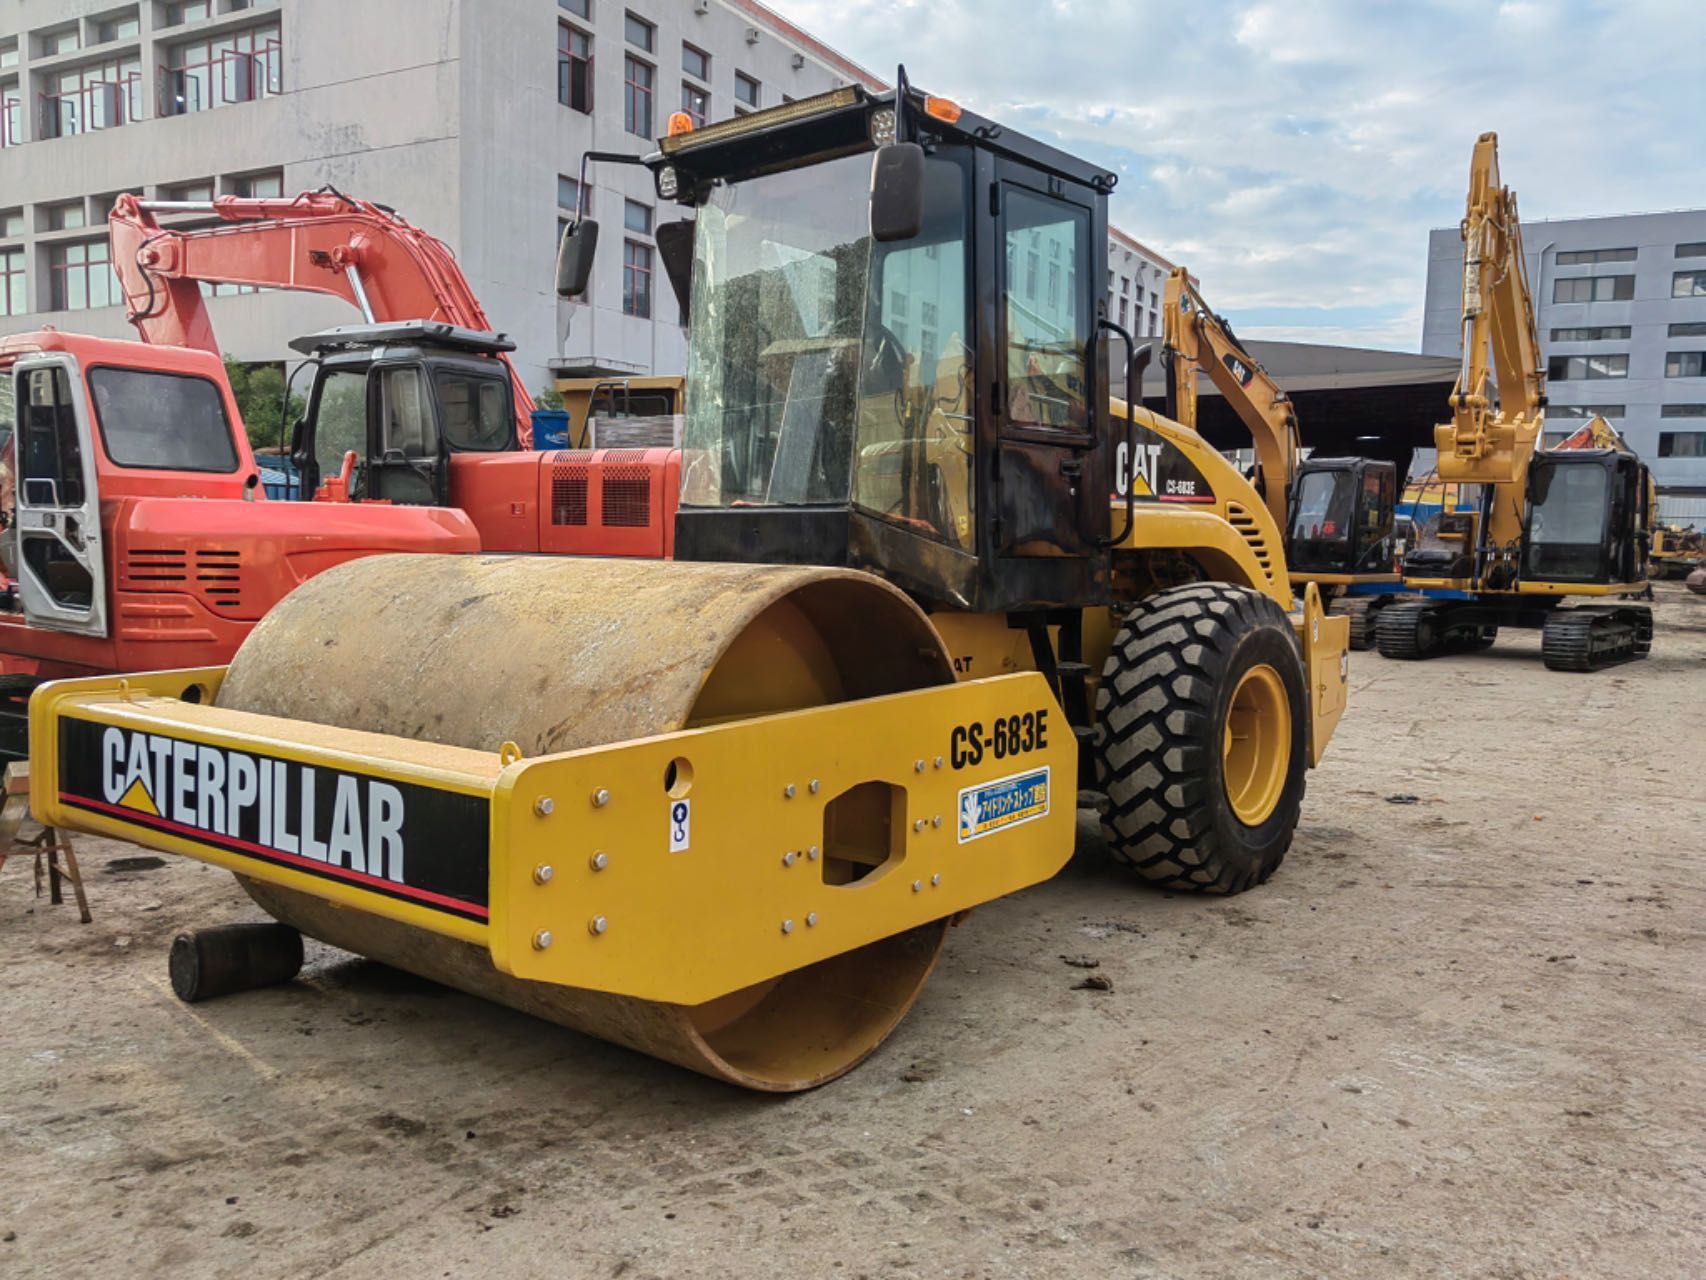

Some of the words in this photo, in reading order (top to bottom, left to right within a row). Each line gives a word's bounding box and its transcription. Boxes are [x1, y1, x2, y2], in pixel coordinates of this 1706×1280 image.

[1115, 441, 1162, 496] CAT
[1166, 479, 1195, 495] CS-683E
[951, 709, 1048, 770] CS-683E
[102, 726, 405, 884] CATERPILLAR
